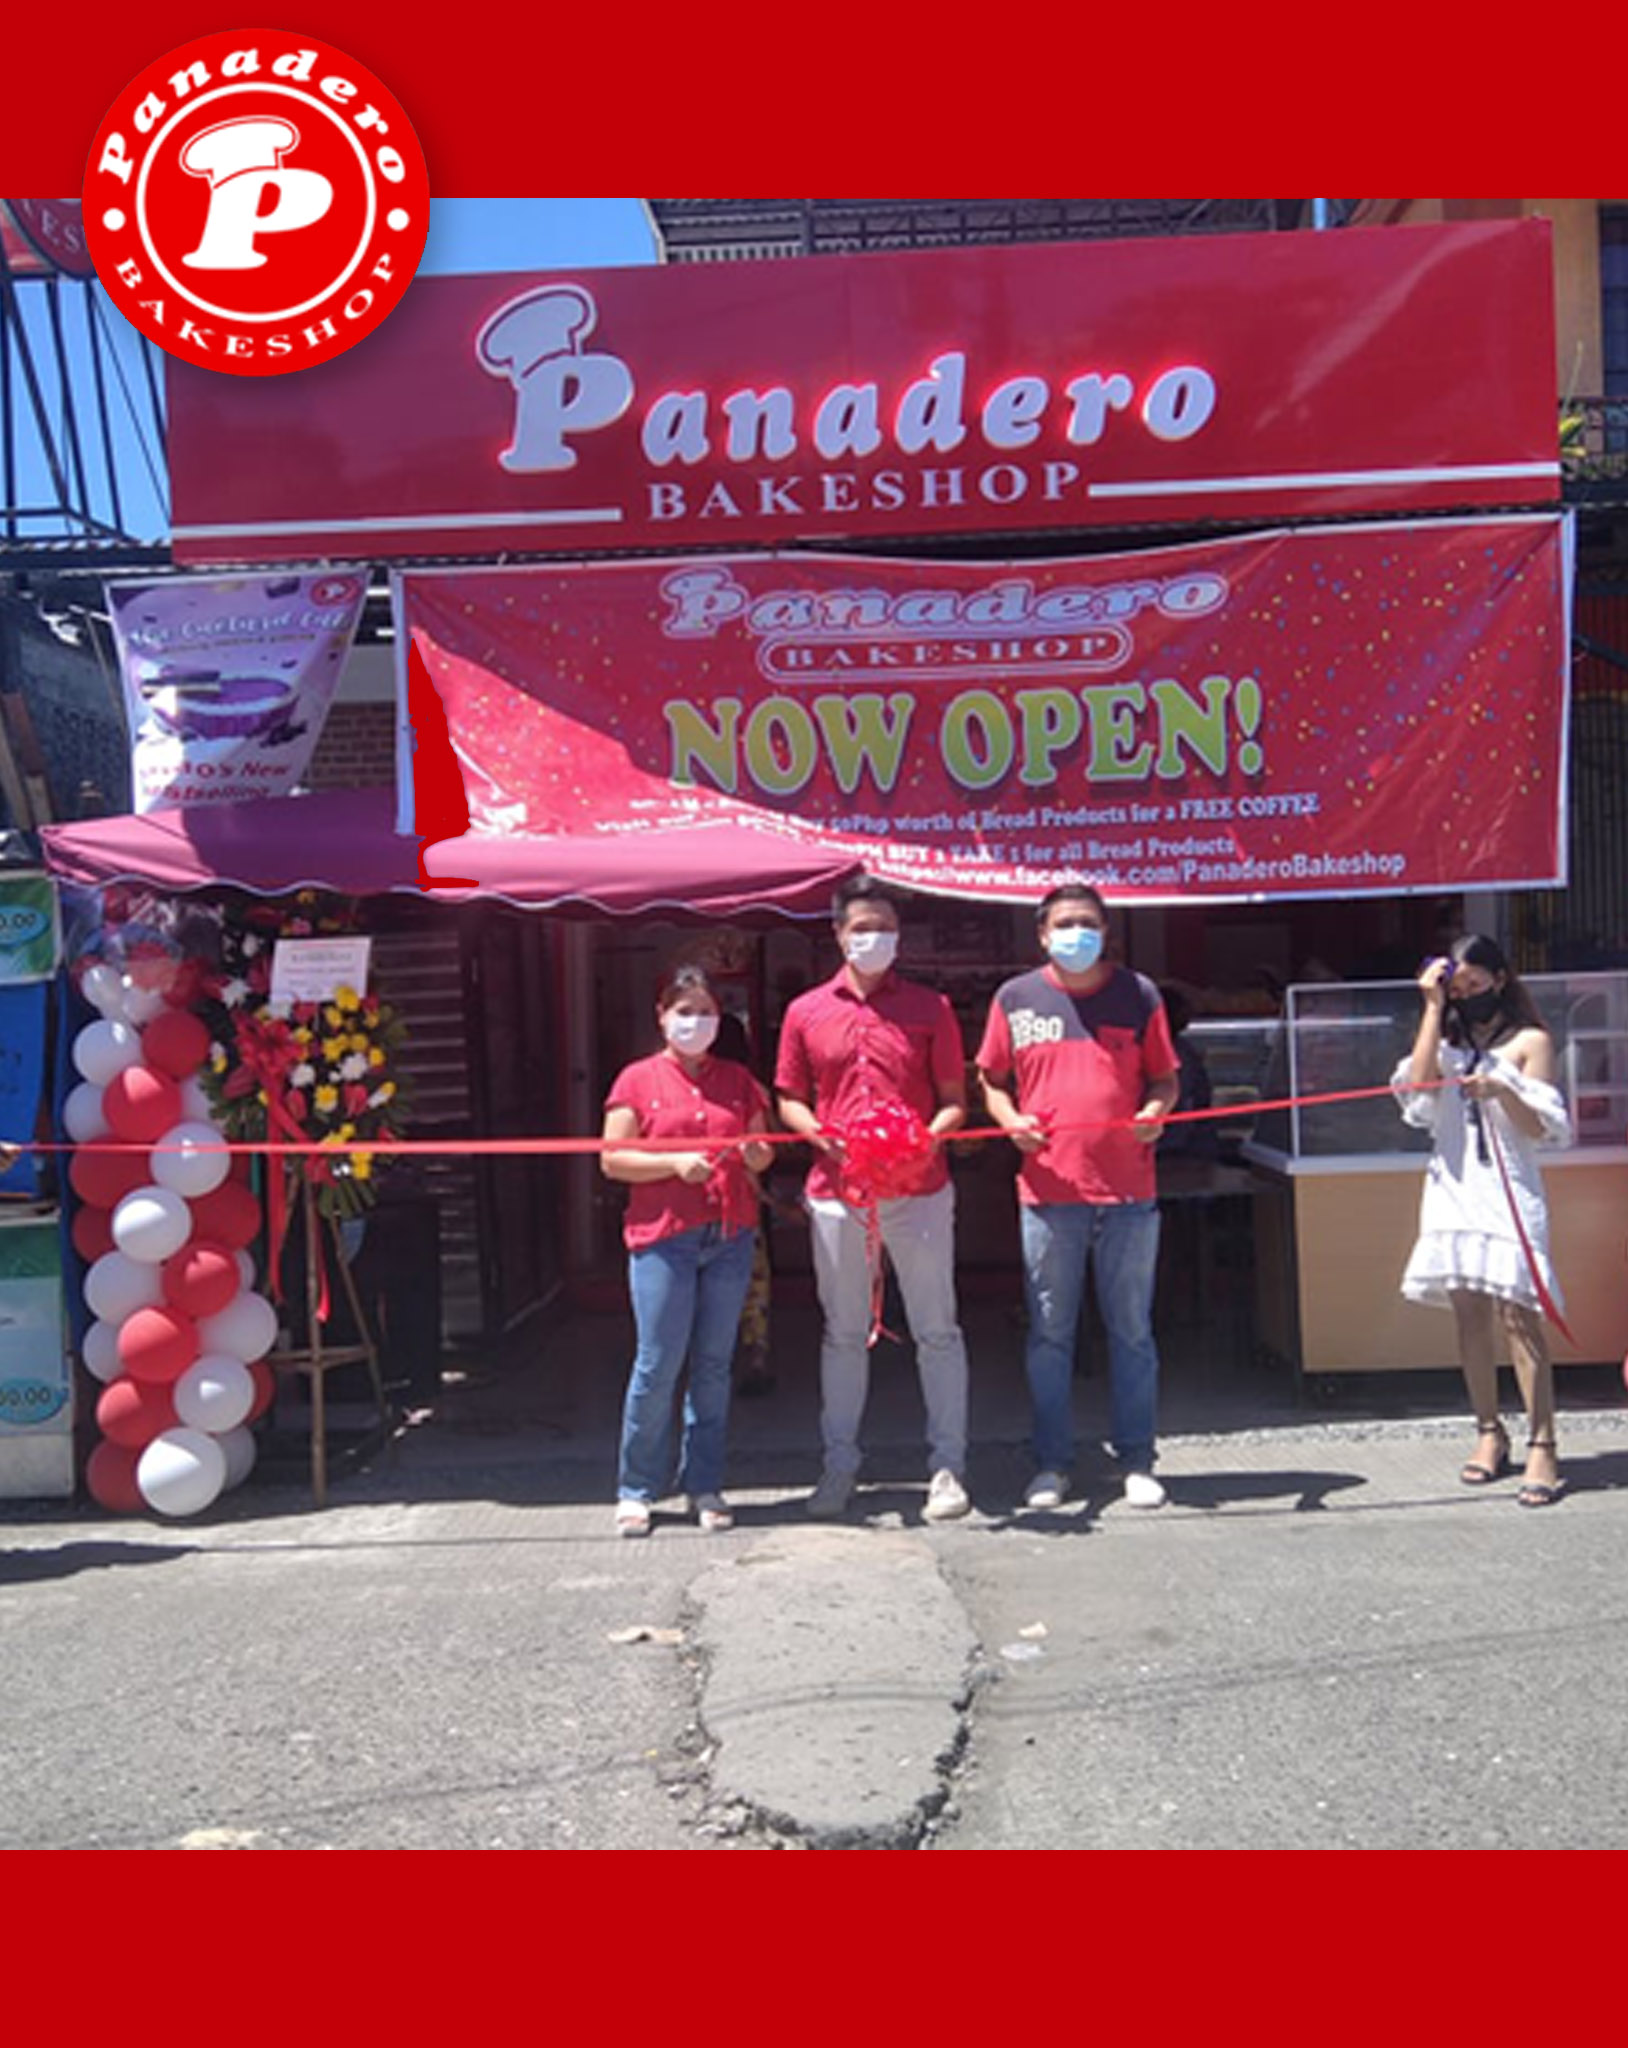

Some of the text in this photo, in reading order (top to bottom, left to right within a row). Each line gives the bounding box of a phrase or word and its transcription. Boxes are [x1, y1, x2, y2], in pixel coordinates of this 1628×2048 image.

[498, 351, 1217, 474] Panadero
[646, 461, 1081, 521] BAKESHOP
[661, 566, 1229, 638] Panadero
[784, 635, 1111, 668] BAKESHOP
[663, 676, 1264, 794] NOW OPEN!
[894, 815, 953, 832] worth
[957, 810, 977, 830] of
[981, 809, 1036, 829] Bread
[1041, 807, 1127, 826] Products
[1131, 803, 1161, 823] for
[1165, 809, 1176, 822] a
[1180, 798, 1234, 820] FREE
[1237, 793, 1321, 817] COFFEE
[952, 844, 1005, 864] TAKE
[1024, 844, 1051, 861] for
[1058, 840, 1083, 860] all
[1088, 838, 1142, 859] Bread
[1146, 836, 1235, 857] Products
